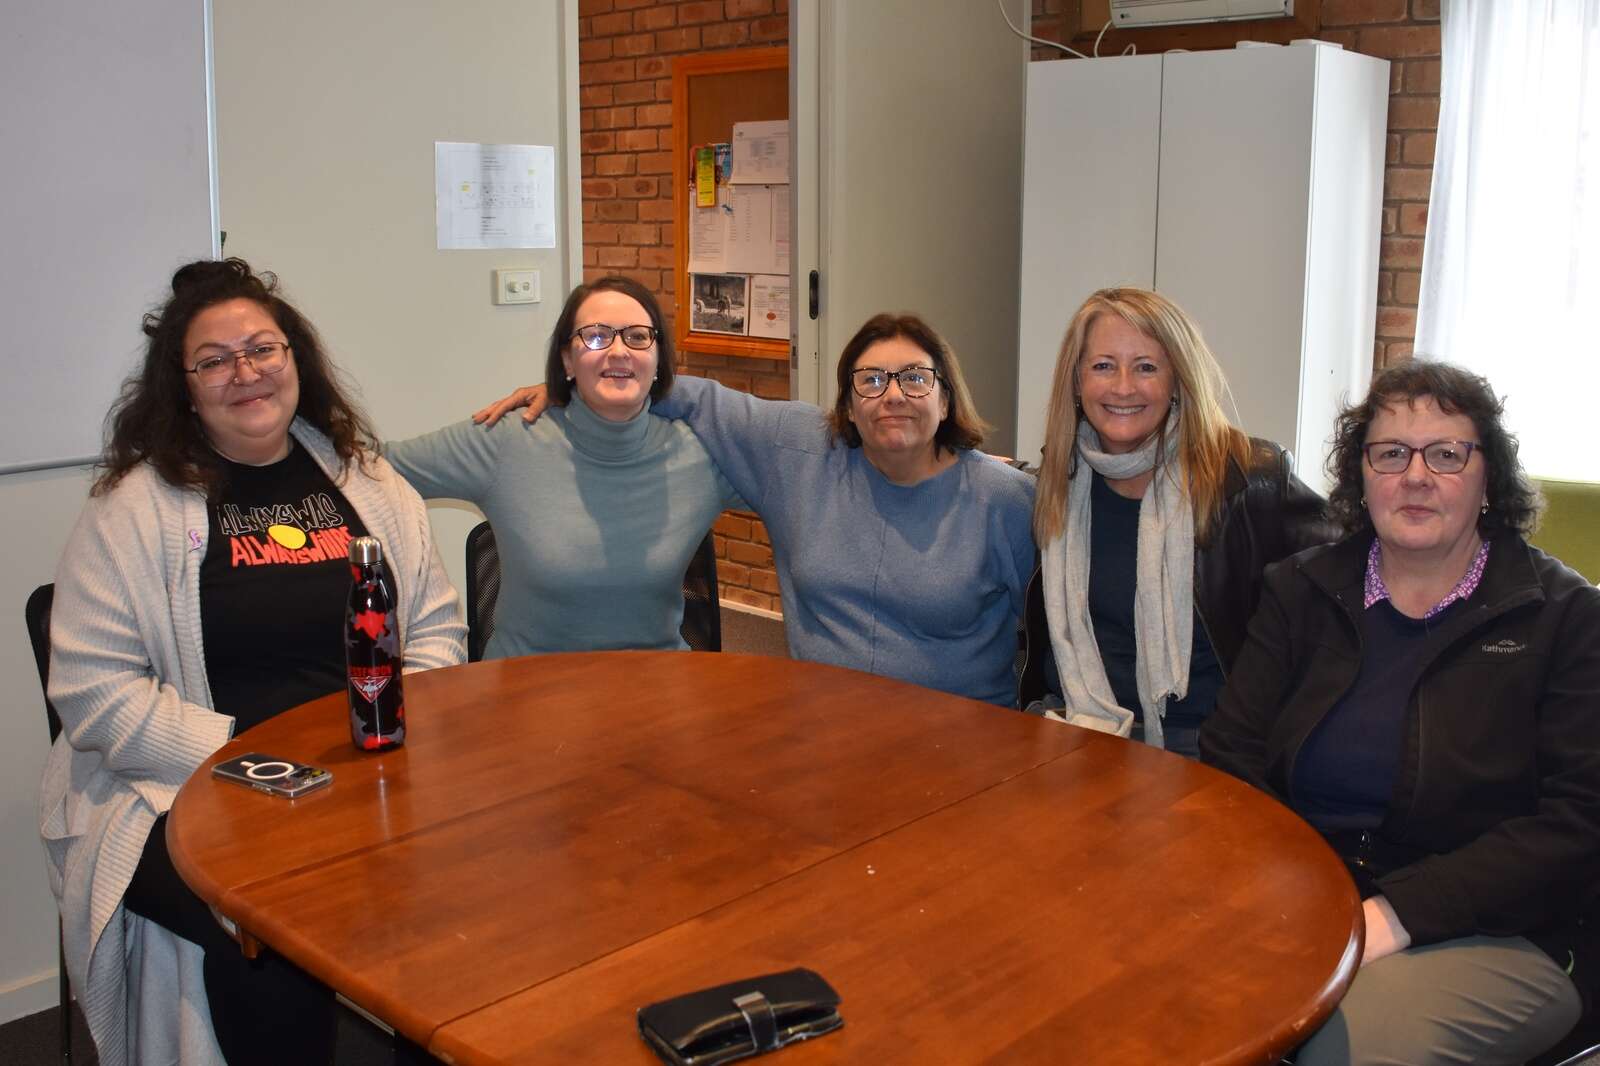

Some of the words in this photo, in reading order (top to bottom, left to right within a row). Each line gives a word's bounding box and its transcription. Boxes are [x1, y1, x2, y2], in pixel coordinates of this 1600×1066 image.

[217, 503, 293, 536] ALWAYS
[289, 492, 344, 533] WAS
[230, 535, 312, 568] ALWAYS
